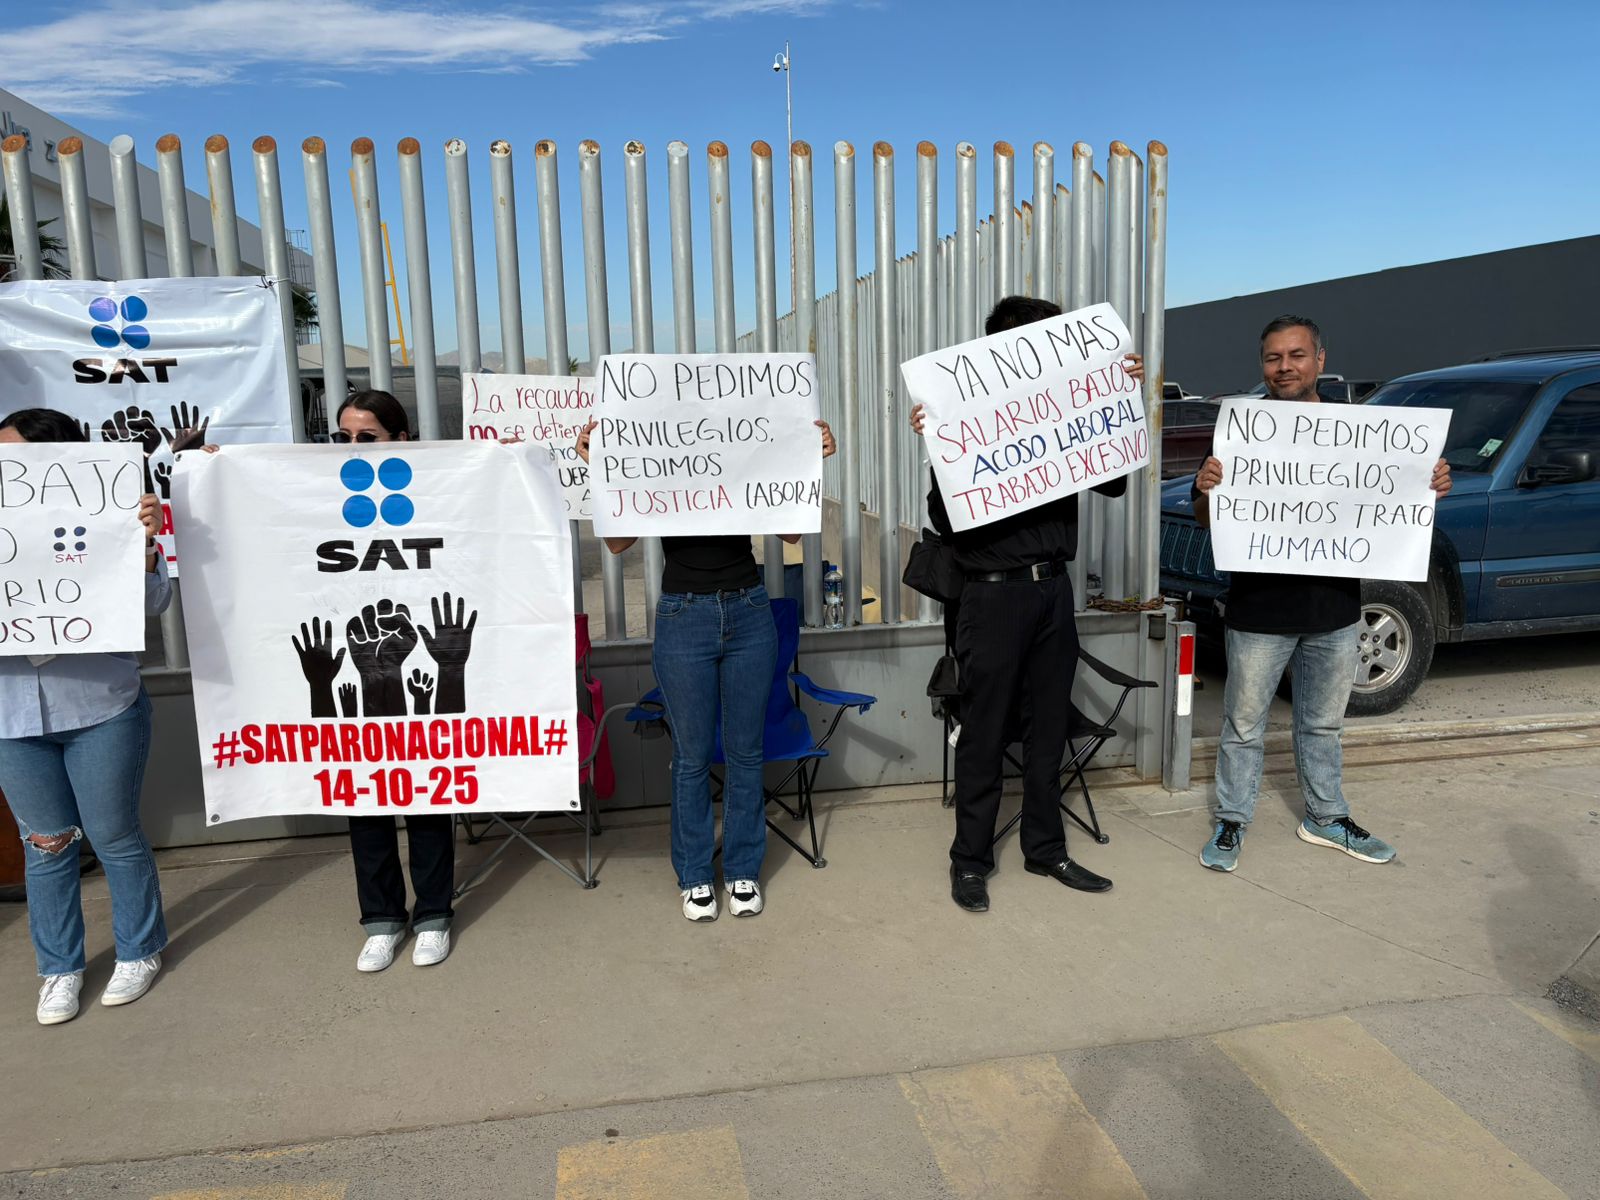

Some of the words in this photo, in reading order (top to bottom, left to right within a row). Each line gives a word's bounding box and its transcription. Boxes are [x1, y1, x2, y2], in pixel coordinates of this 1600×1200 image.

[72, 357, 178, 385] SAT
[936, 354, 990, 402] YA
[989, 336, 1043, 389] NO
[1045, 315, 1120, 368] MAS
[471, 377, 506, 414] La
[515, 377, 595, 410] recauda
[601, 360, 657, 403] NO
[674, 360, 813, 402] PEDIMOS
[937, 388, 1062, 464] SALARIOS
[1068, 359, 1137, 409] BAJOS
[1226, 407, 1277, 445] NO
[1292, 415, 1429, 455] PEDIMOS
[972, 434, 1047, 485] ACOSO
[1054, 398, 1144, 453] LABORAL
[0, 459, 143, 516] BAJO
[603, 452, 723, 483] PEDIMOS
[951, 460, 1061, 520] TRABAJO
[1065, 428, 1148, 484] EXCESIVO
[1231, 456, 1400, 495] PRIVILEGIOS
[607, 484, 734, 518] JUSTICIA
[1216, 495, 1338, 525] PEDIMOS
[1354, 504, 1435, 529] TRATO
[55, 553, 89, 564] SAT
[316, 537, 444, 573] SAT
[1248, 532, 1371, 563] HUMANO
[212, 715, 568, 769] #SATPARONACIONAL#
[313, 764, 479, 807] 14-10-25
